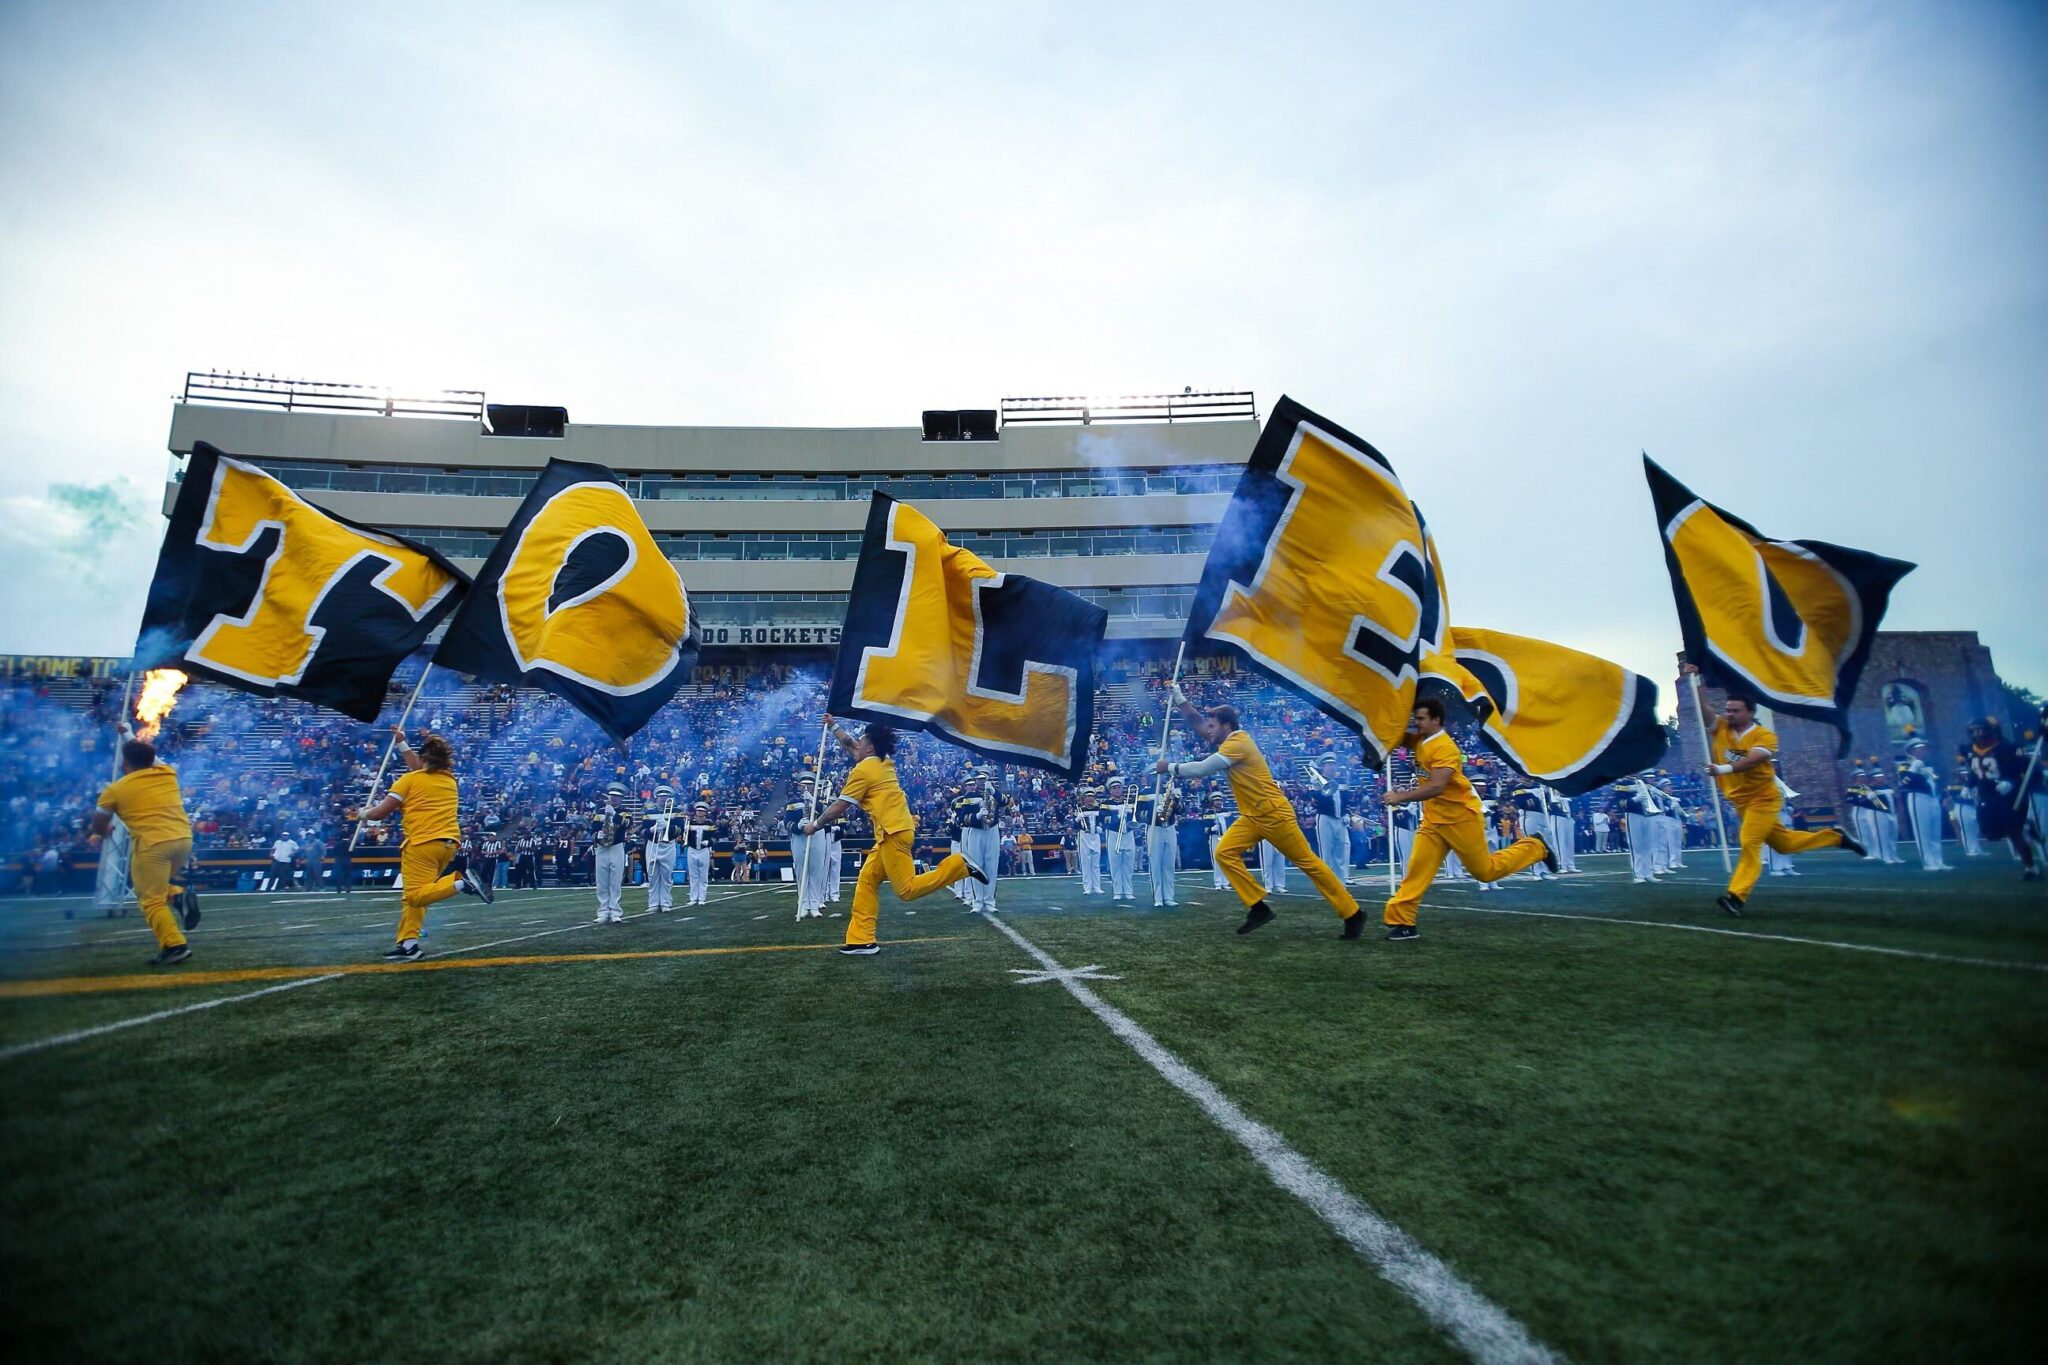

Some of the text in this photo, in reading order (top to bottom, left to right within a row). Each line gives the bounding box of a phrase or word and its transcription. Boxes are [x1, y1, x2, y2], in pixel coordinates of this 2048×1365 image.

[184, 456, 458, 687] T
[497, 481, 690, 697] O
[739, 628, 841, 644] ROCKETS
[851, 500, 1078, 770] L
